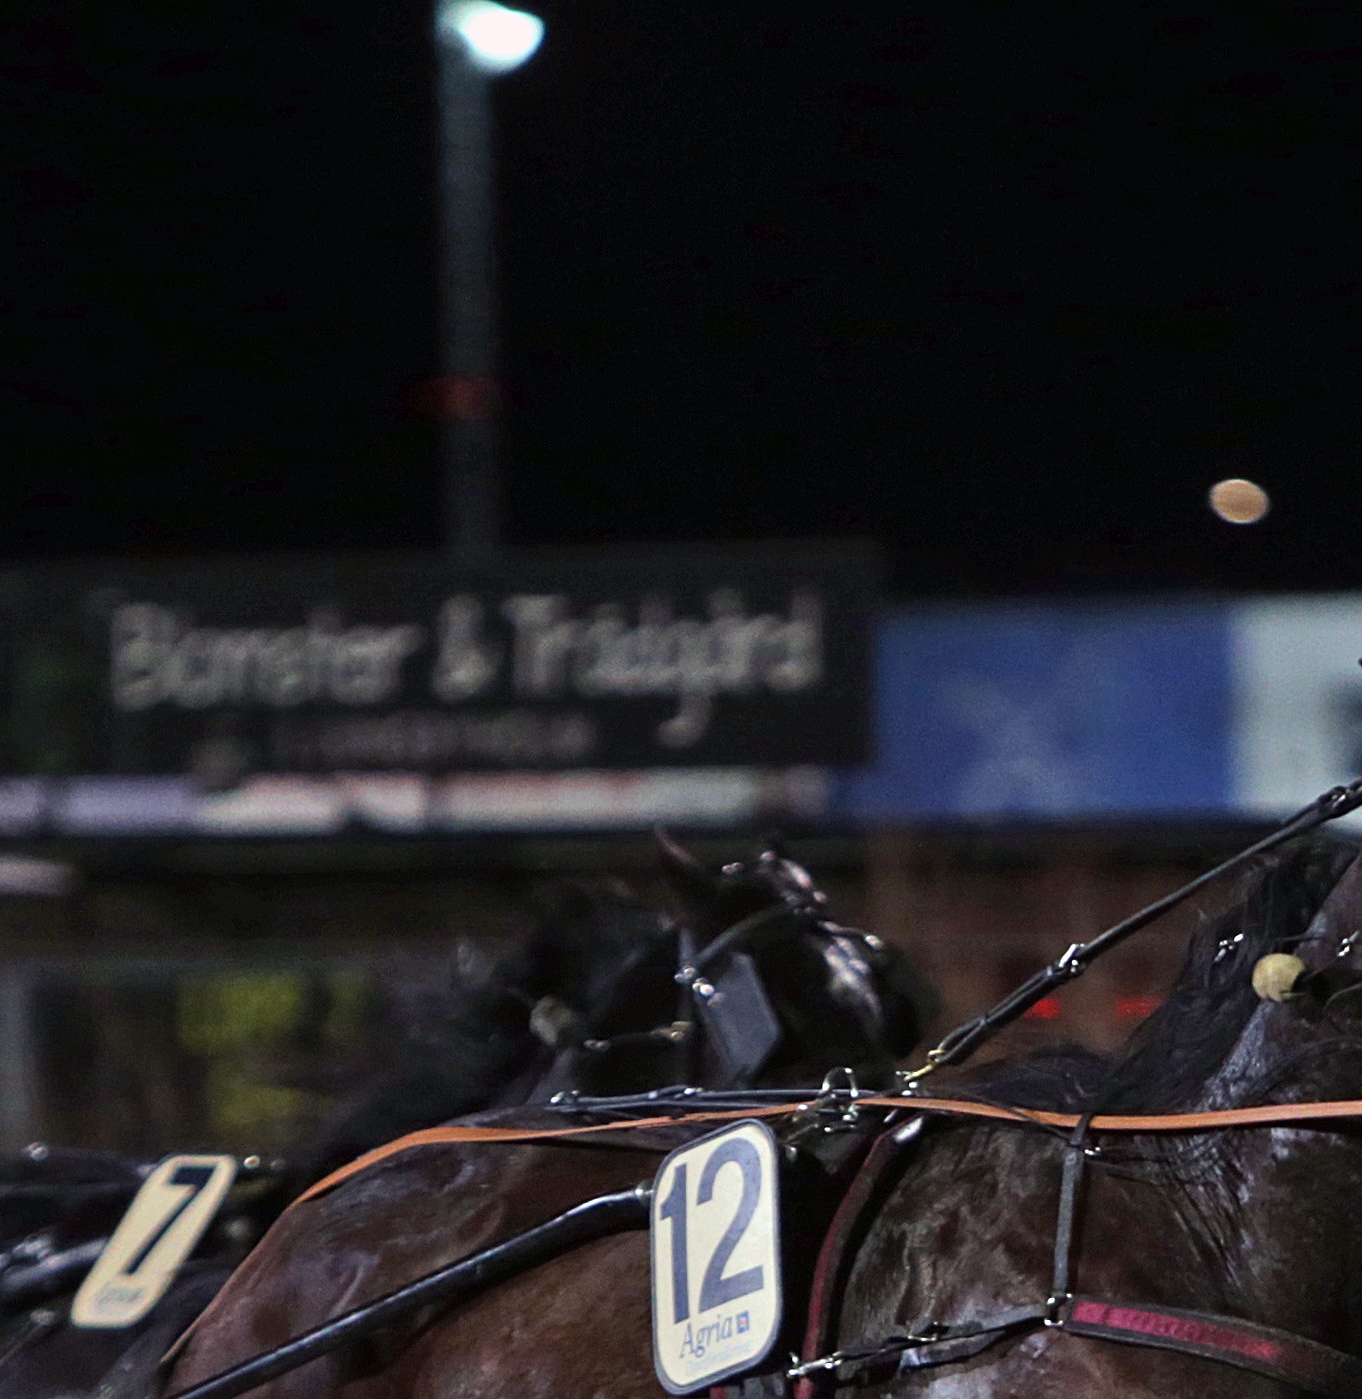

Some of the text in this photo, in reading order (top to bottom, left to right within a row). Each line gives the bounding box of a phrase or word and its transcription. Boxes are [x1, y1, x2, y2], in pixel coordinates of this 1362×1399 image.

[123, 1166, 217, 1276] 7
[660, 1136, 765, 1325] 12
[679, 1311, 734, 1359] Agria
